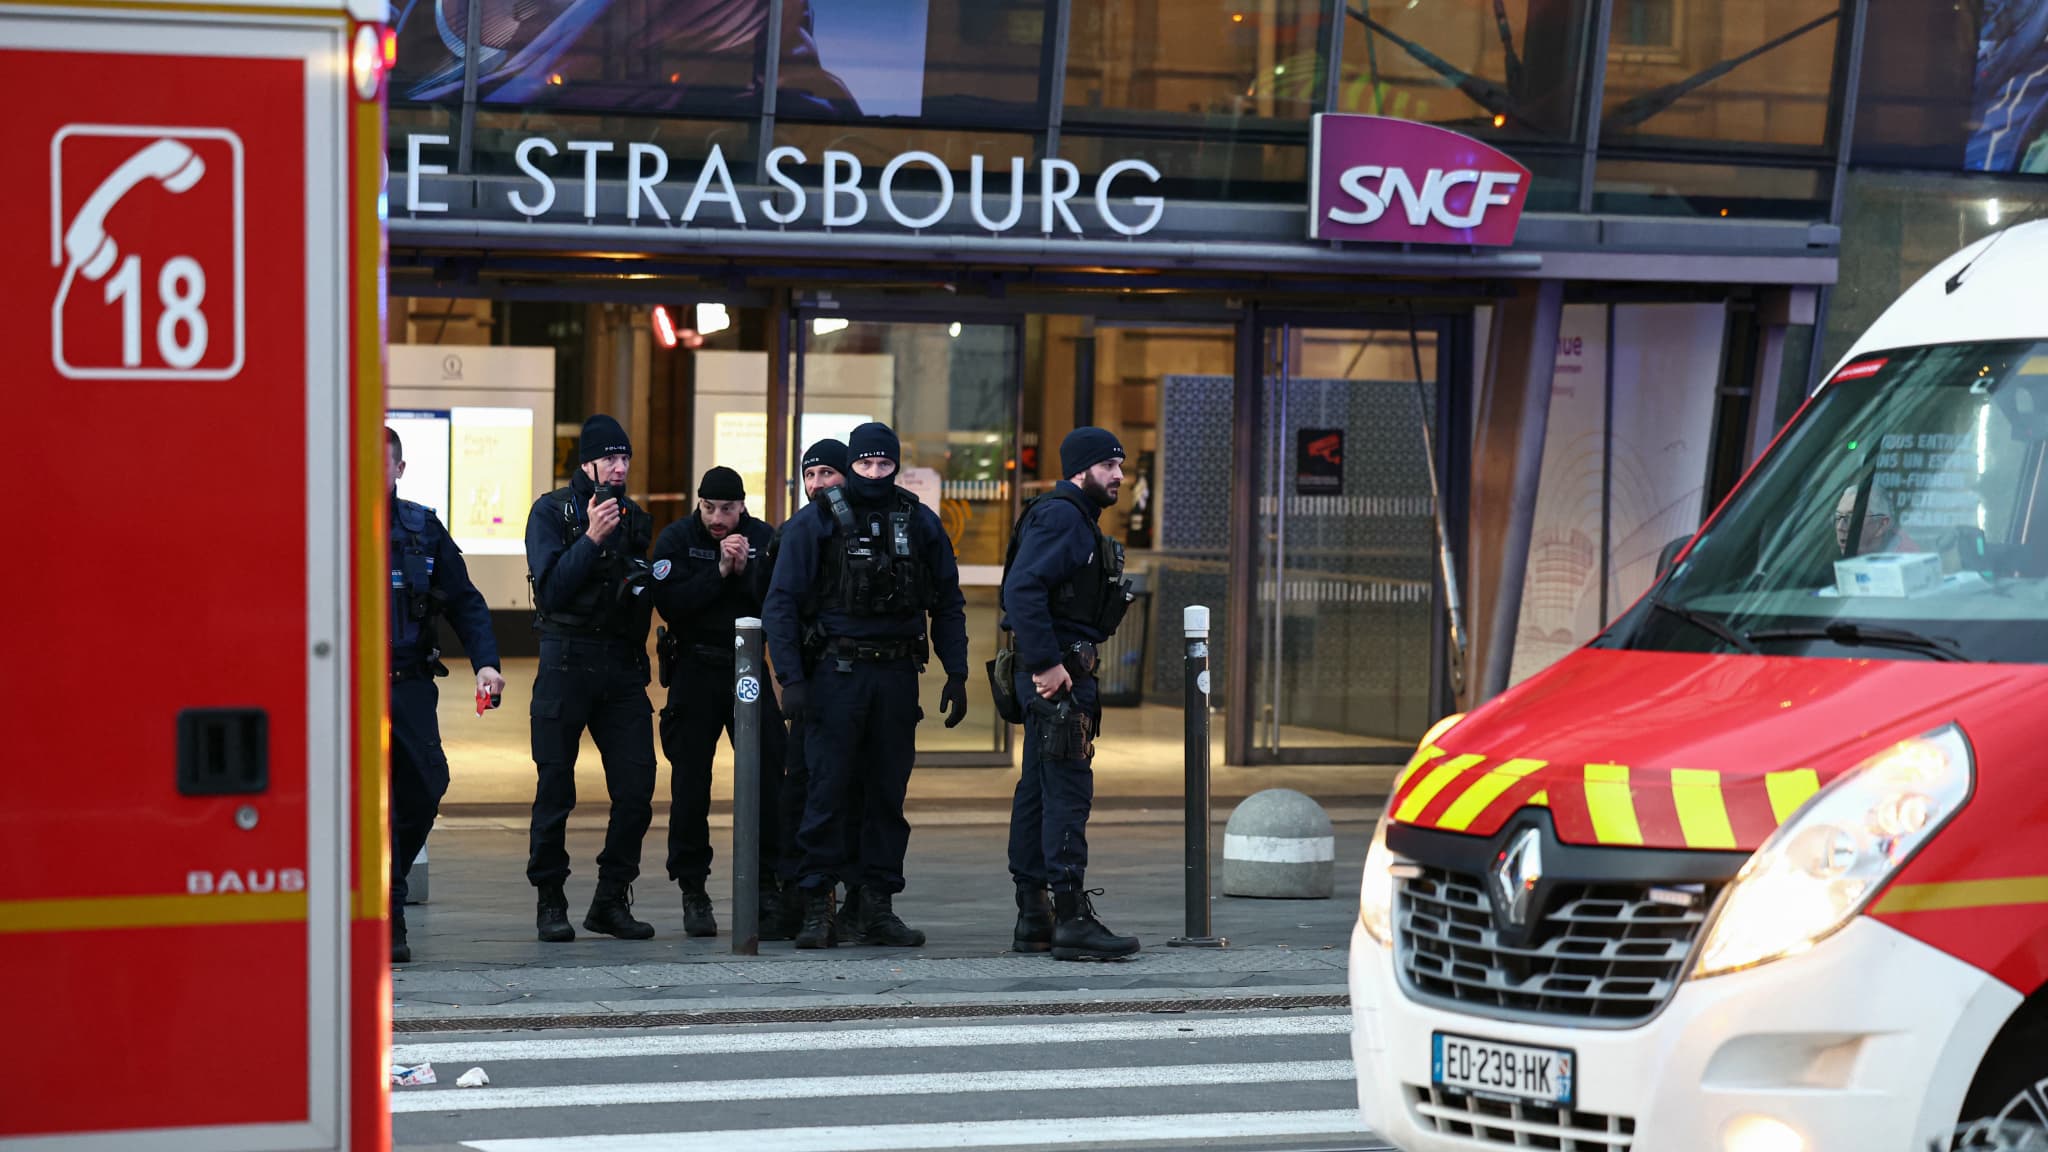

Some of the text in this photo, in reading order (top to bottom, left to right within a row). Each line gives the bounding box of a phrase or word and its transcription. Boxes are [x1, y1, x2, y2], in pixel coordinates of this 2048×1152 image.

[382, 134, 1164, 236] E STRASBOURG
[1328, 165, 1521, 228] SNCF
[104, 254, 208, 368] 18
[858, 450, 886, 458] POLICE
[187, 868, 305, 894] BAUS
